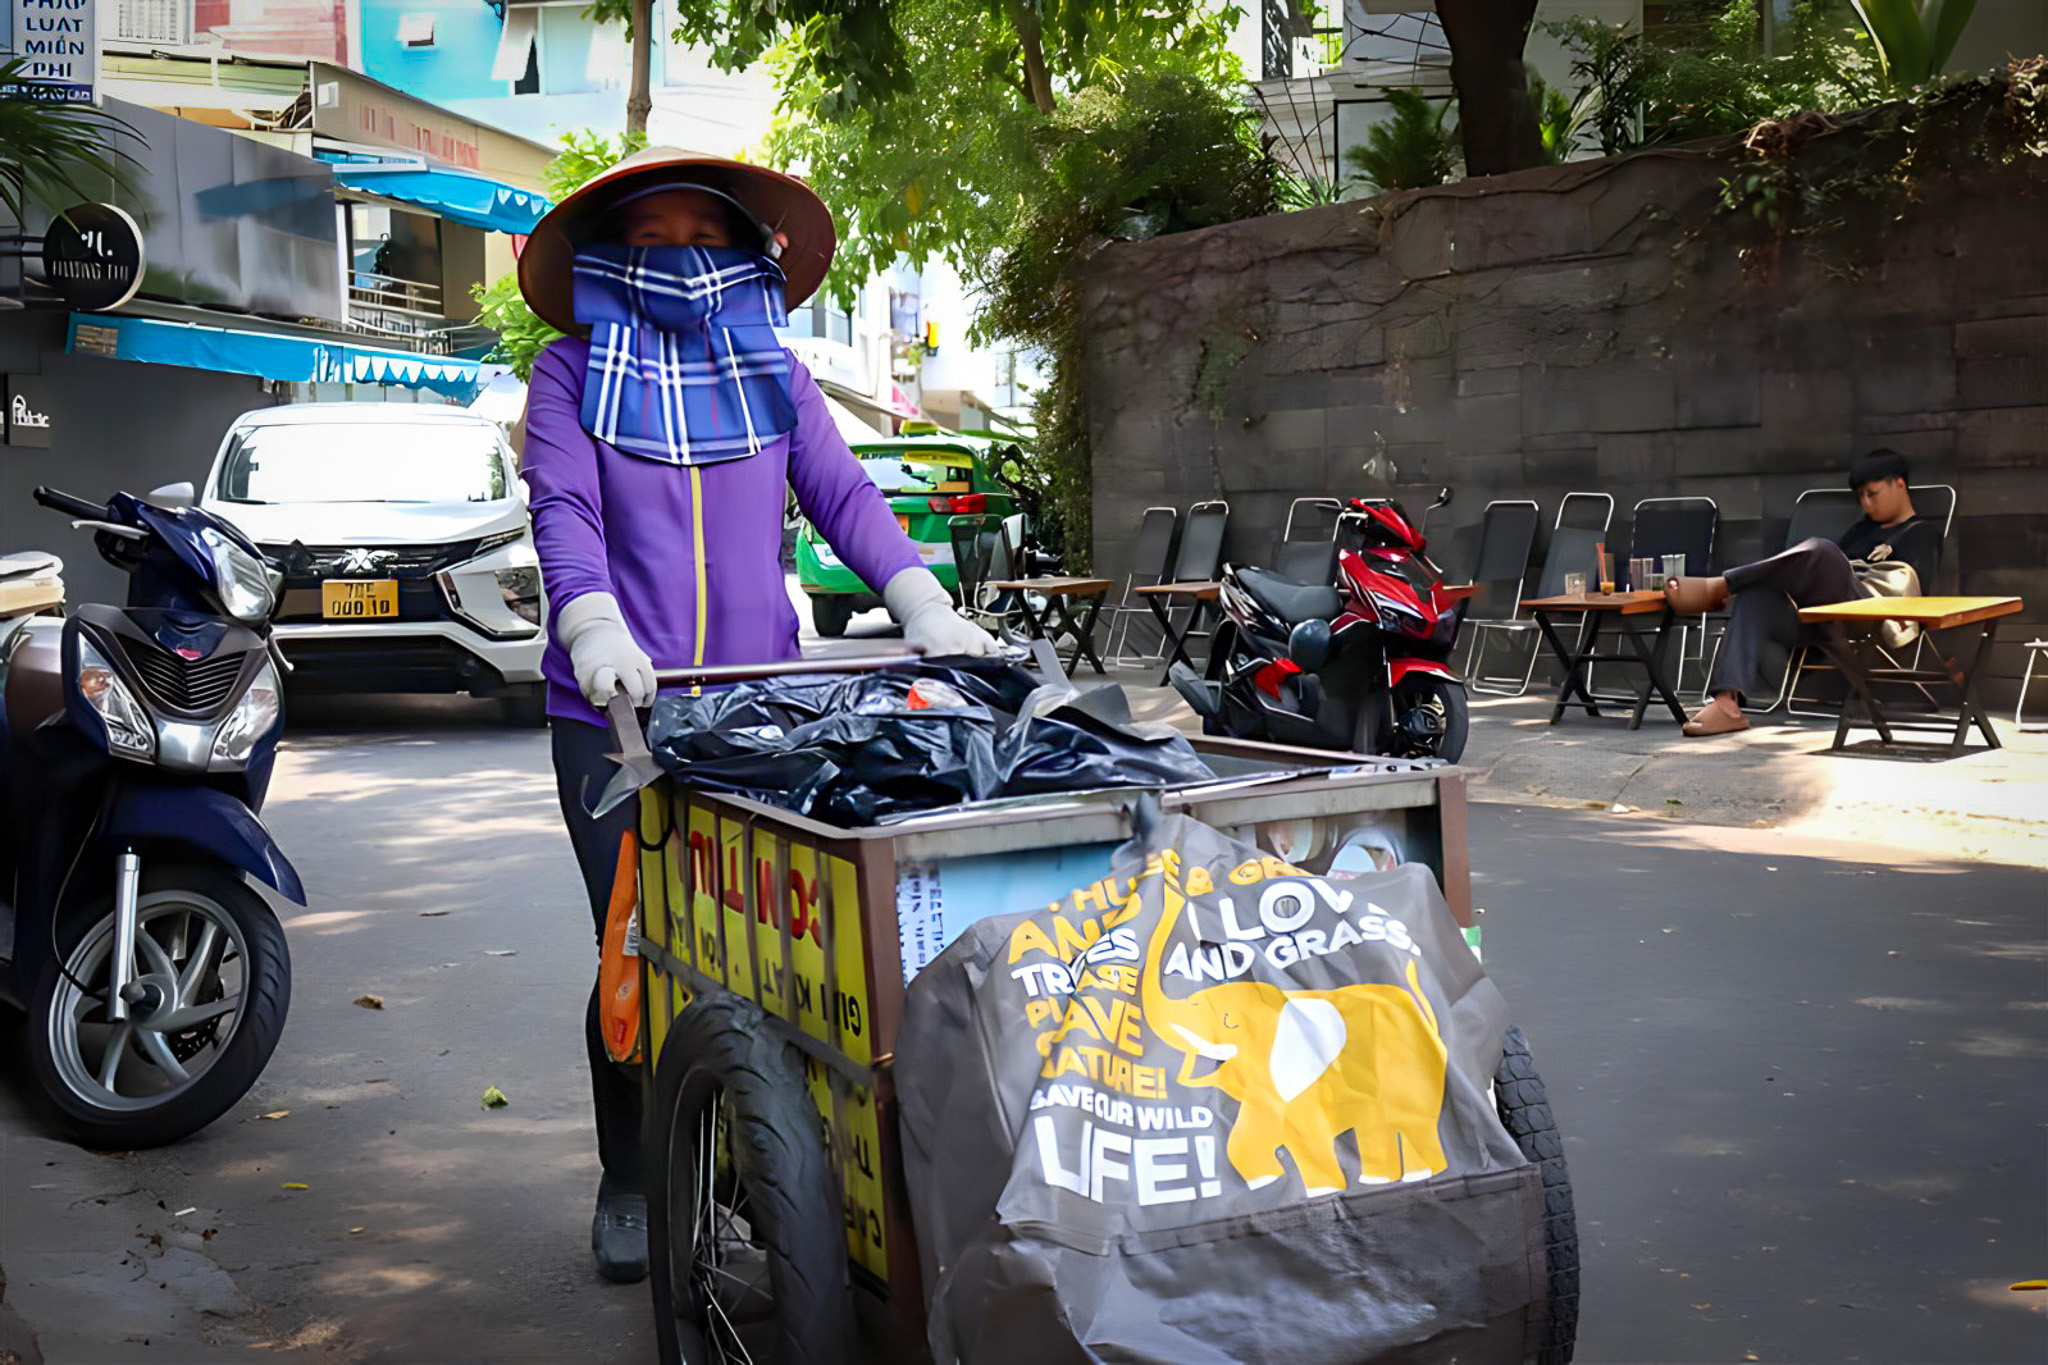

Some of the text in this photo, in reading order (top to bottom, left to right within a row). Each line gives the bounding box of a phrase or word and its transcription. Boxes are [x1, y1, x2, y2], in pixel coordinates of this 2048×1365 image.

[1164, 941, 1257, 983] AND
[1040, 1046, 1169, 1099] ATURE!
[1137, 1105, 1215, 1131] WILD
[1033, 1115, 1223, 1207] LIFE!
